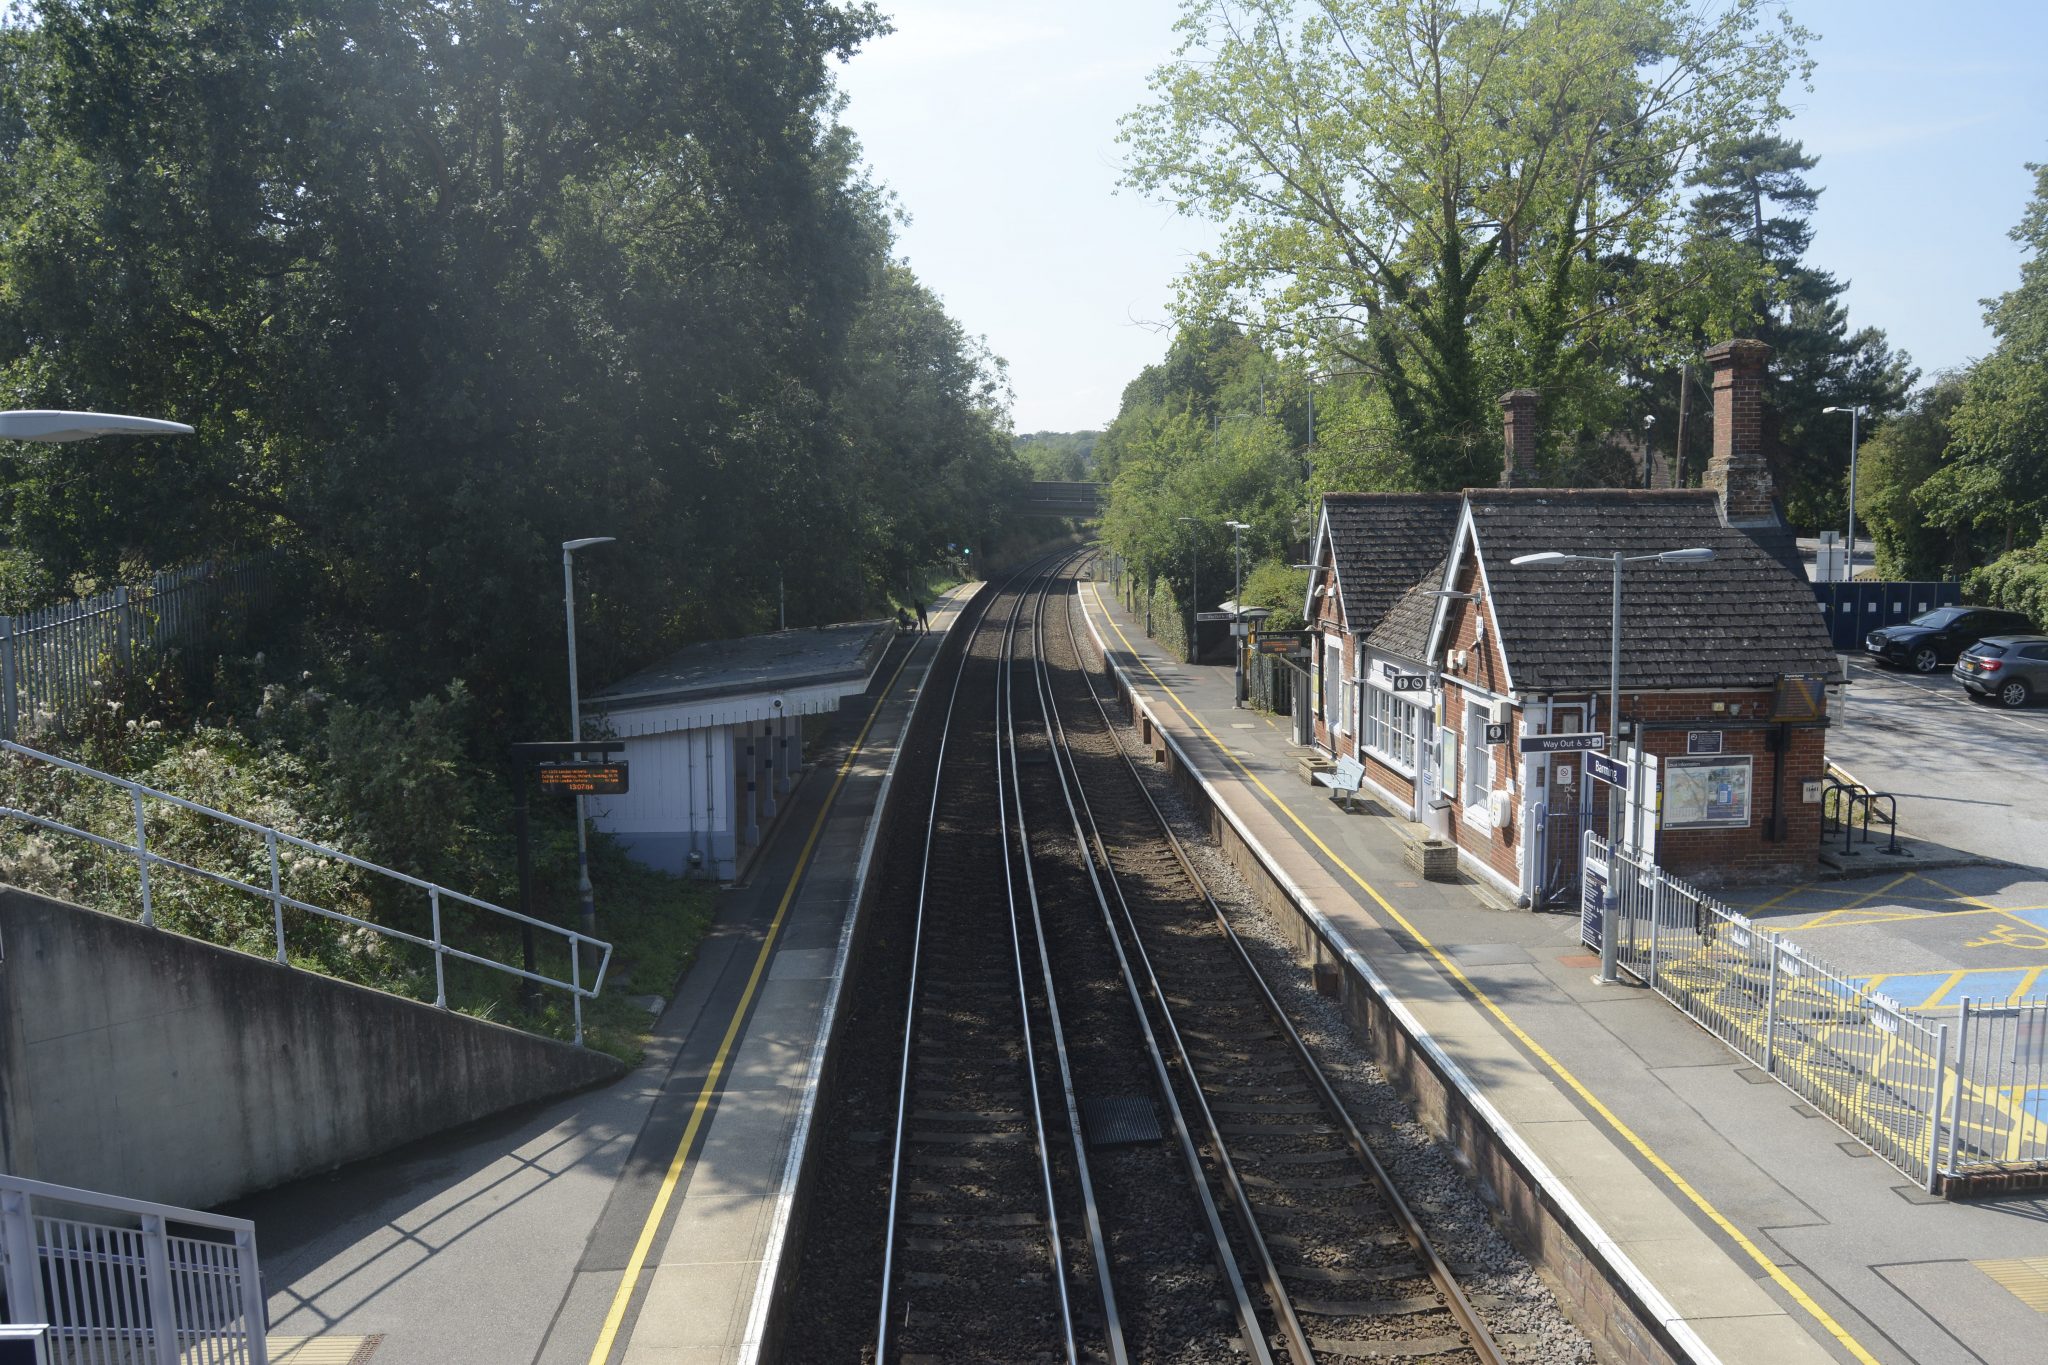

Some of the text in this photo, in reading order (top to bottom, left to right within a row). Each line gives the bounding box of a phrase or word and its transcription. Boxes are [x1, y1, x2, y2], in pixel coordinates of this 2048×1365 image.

[1543, 739, 1574, 748] Way Out
[1595, 760, 1618, 782] Barming
